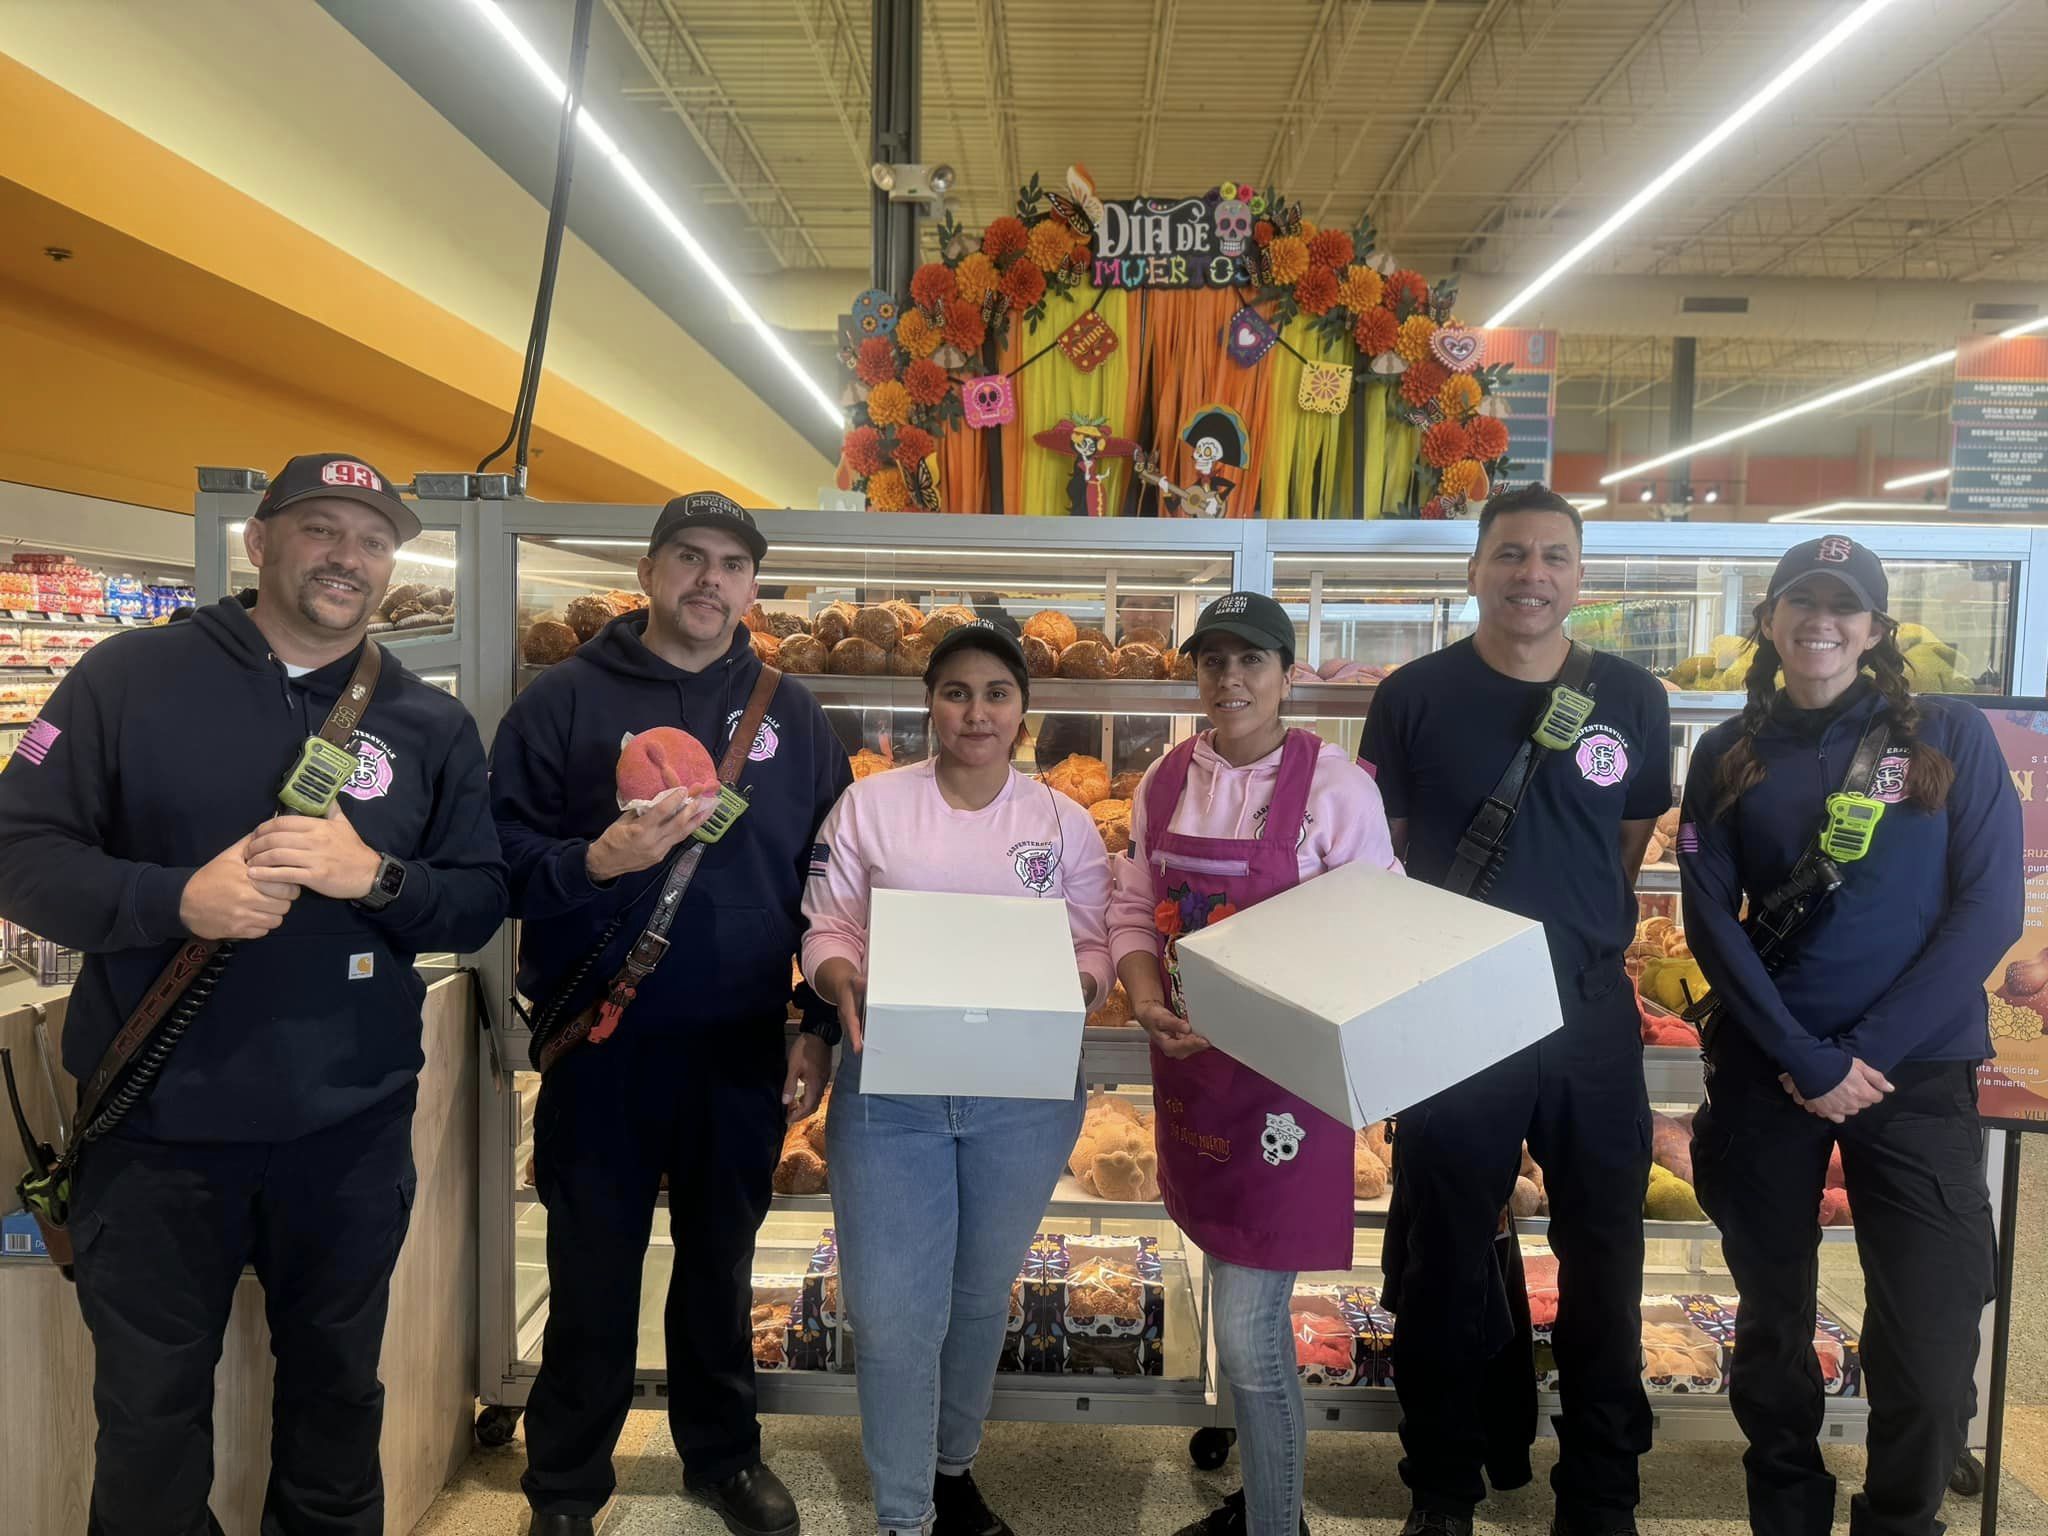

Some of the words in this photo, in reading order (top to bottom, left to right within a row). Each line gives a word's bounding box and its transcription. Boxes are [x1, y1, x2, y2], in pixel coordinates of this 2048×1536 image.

[1175, 223, 1211, 252] DE
[335, 464, 372, 491] 93
[1216, 600, 1248, 610] FRESH
[1215, 607, 1245, 615] MARKET
[2003, 1066, 2025, 1074] ciclo
[2028, 1067, 2040, 1076] de
[1983, 1077, 1991, 1086] la
